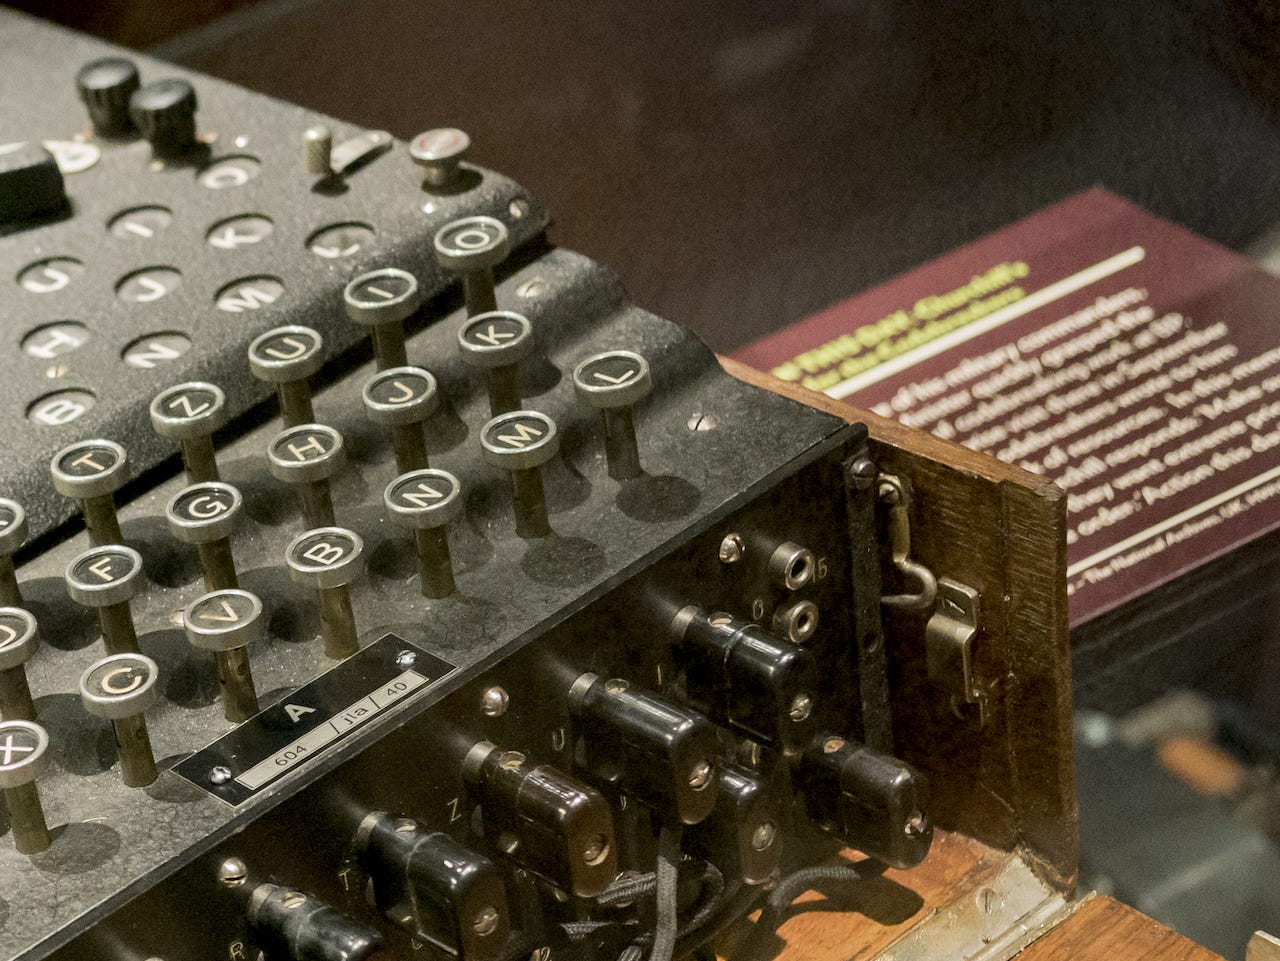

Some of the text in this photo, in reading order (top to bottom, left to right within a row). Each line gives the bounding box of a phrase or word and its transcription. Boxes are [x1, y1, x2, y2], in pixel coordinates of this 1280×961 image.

[22, 267, 69, 292] U
[201, 165, 248, 188] O
[30, 333, 82, 360] H
[135, 278, 166, 300] J
[215, 228, 266, 248] K
[36, 398, 82, 424] B
[132, 344, 177, 368] N
[215, 289, 264, 312] M
[72, 453, 105, 471] T
[169, 396, 210, 417] Z
[265, 337, 306, 360] U
[367, 286, 394, 298] I
[455, 231, 490, 248] O
[89, 558, 115, 582] F
[188, 495, 227, 519] G
[287, 435, 326, 461] H
[388, 381, 413, 404] J
[476, 325, 515, 346] K
[102, 667, 142, 694] C
[200, 601, 238, 623] V
[303, 542, 344, 566] B
[402, 484, 443, 507] N
[497, 424, 542, 448] M
[593, 369, 634, 385] L
[275, 745, 308, 767] 604
[386, 681, 408, 697] 40
[284, 703, 316, 723] A
